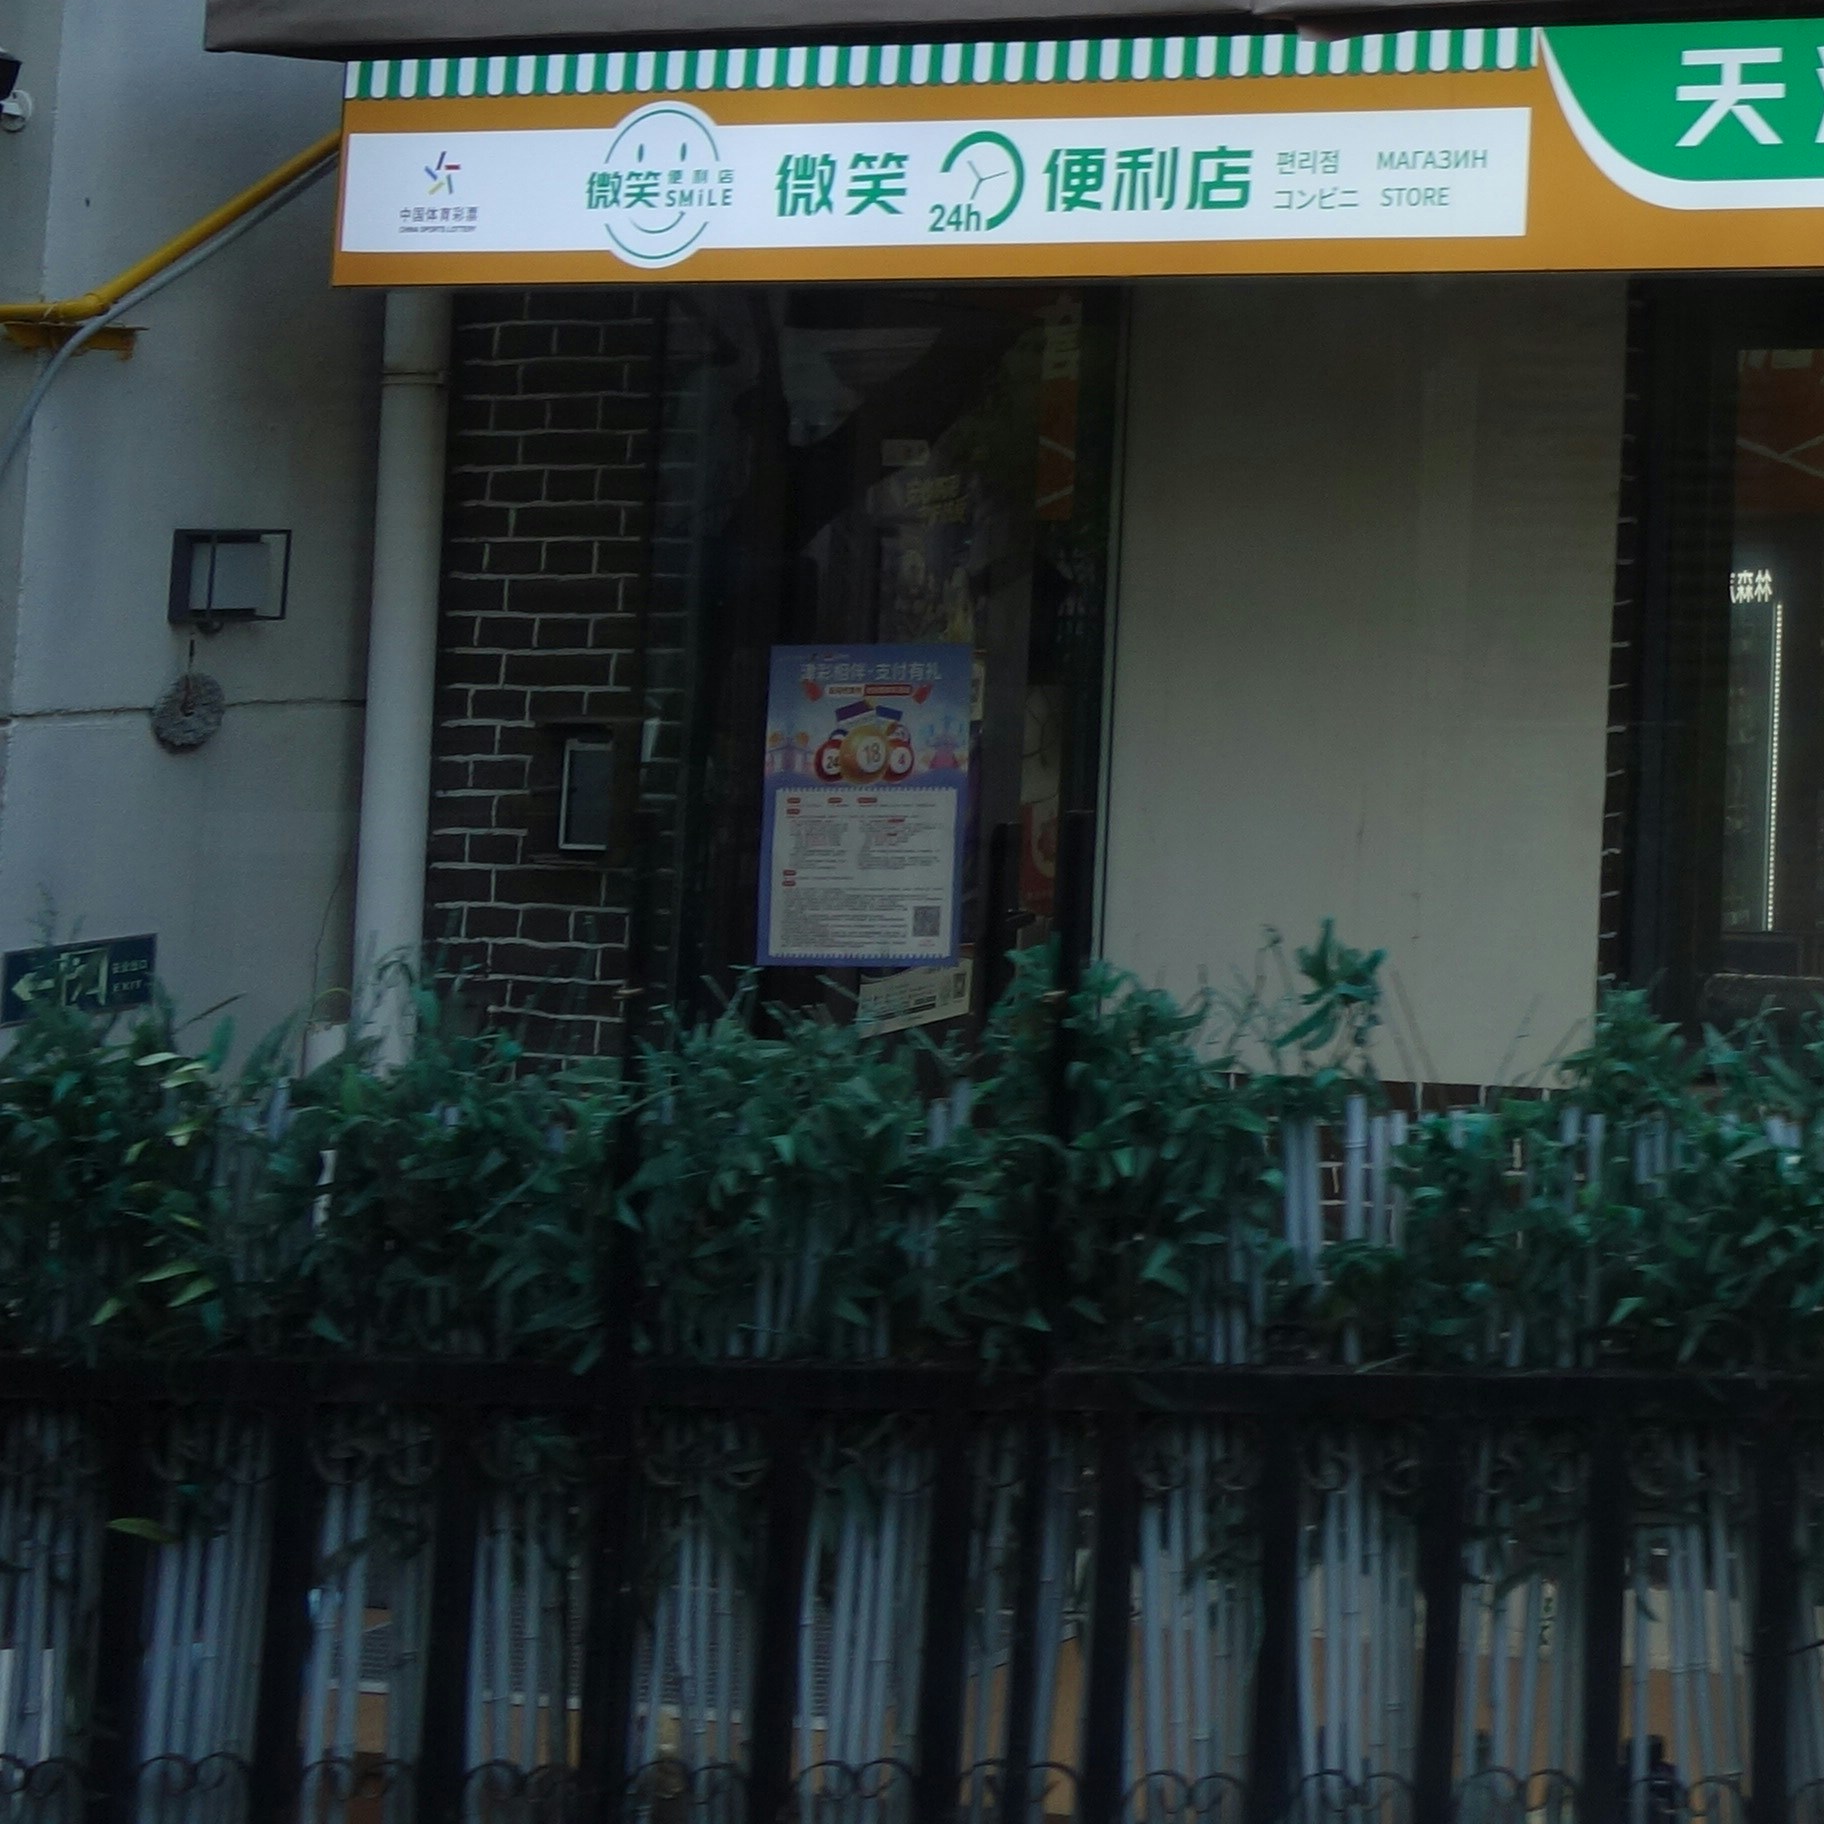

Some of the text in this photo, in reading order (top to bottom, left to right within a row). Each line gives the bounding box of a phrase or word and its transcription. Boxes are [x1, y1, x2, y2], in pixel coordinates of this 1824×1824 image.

[1276, 148, 1489, 175] 편리점 МАГАЗИН
[667, 168, 735, 184] 便利店
[586, 170, 662, 210] 微笑
[775, 145, 1254, 233] 微笑 24h 便利店
[1273, 185, 1451, 210] コンビニ STORE
[400, 206, 479, 223] 中国体育彩票
[862, 743, 882, 765] 18
[112, 979, 142, 992] EXIT
